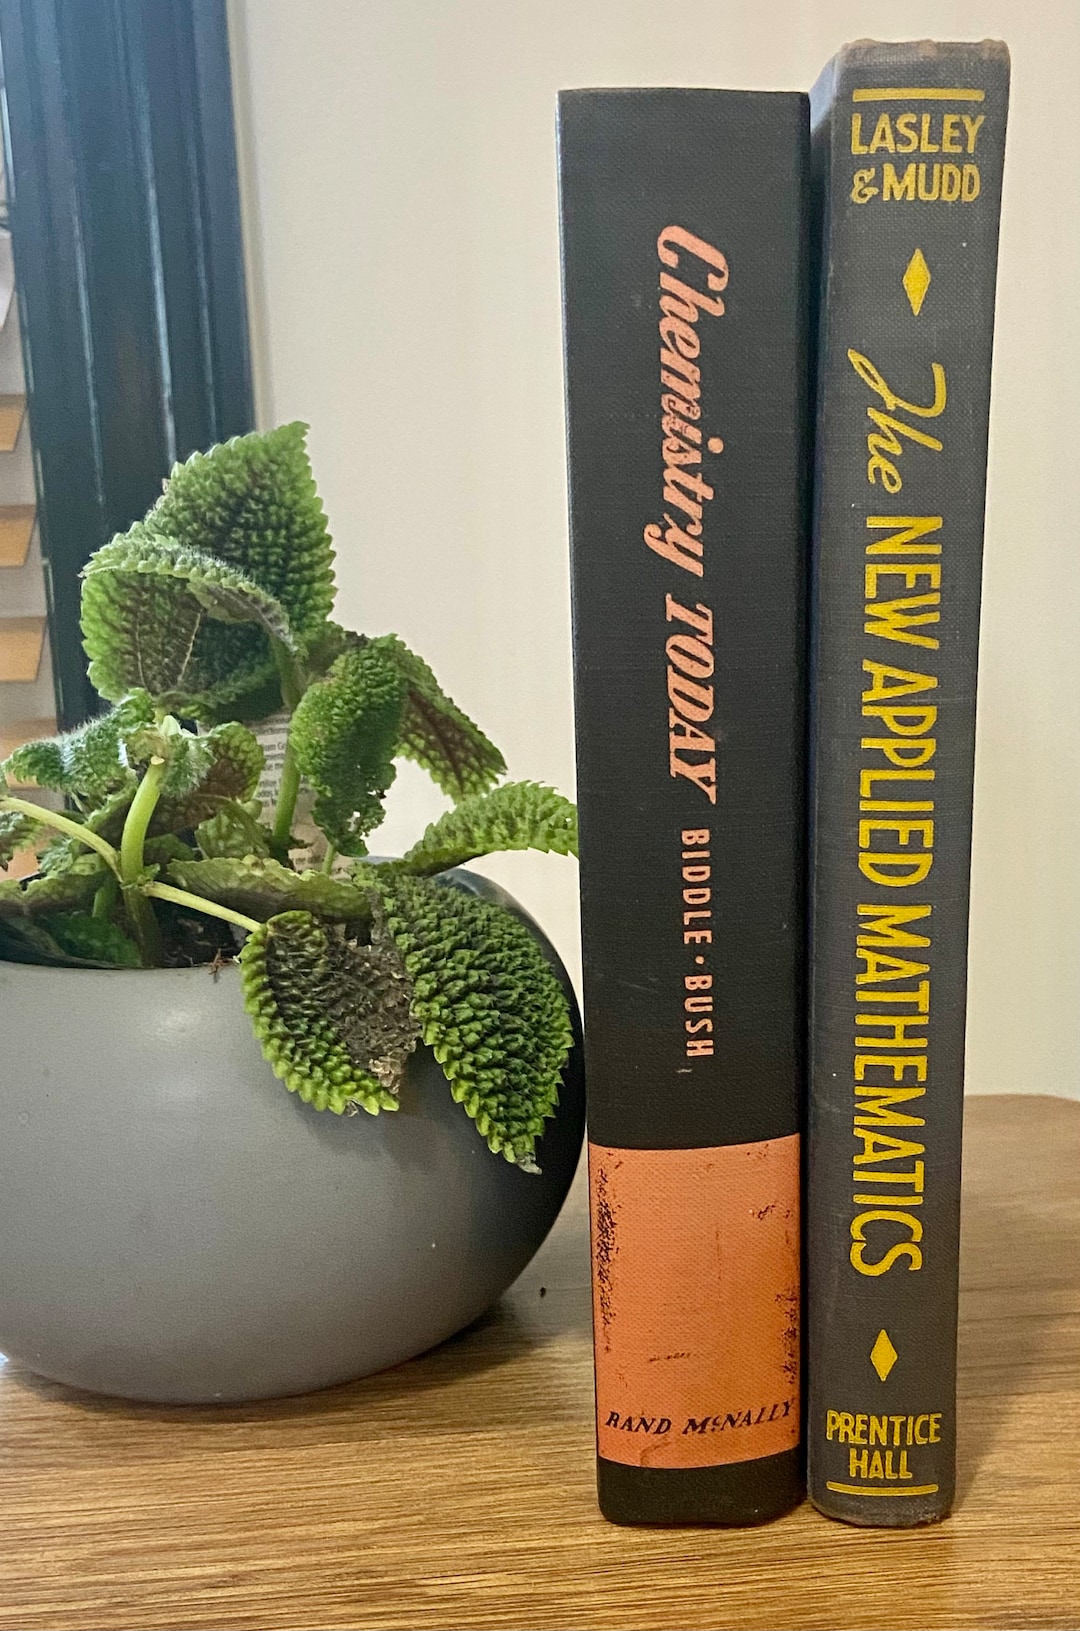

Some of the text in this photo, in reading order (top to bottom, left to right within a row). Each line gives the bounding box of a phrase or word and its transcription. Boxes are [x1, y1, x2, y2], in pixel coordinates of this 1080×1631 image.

[850, 112, 986, 155] LASLEY
[643, 224, 730, 805] Chemistry TODAY
[847, 348, 947, 1278] The NEW APPLIED MATHEMATICS
[680, 828, 715, 1058] BIDDLE BUSH
[605, 1411, 673, 1436] RAND
[825, 1409, 943, 1447] PRENTICE
[847, 1446, 914, 1481] HALL
